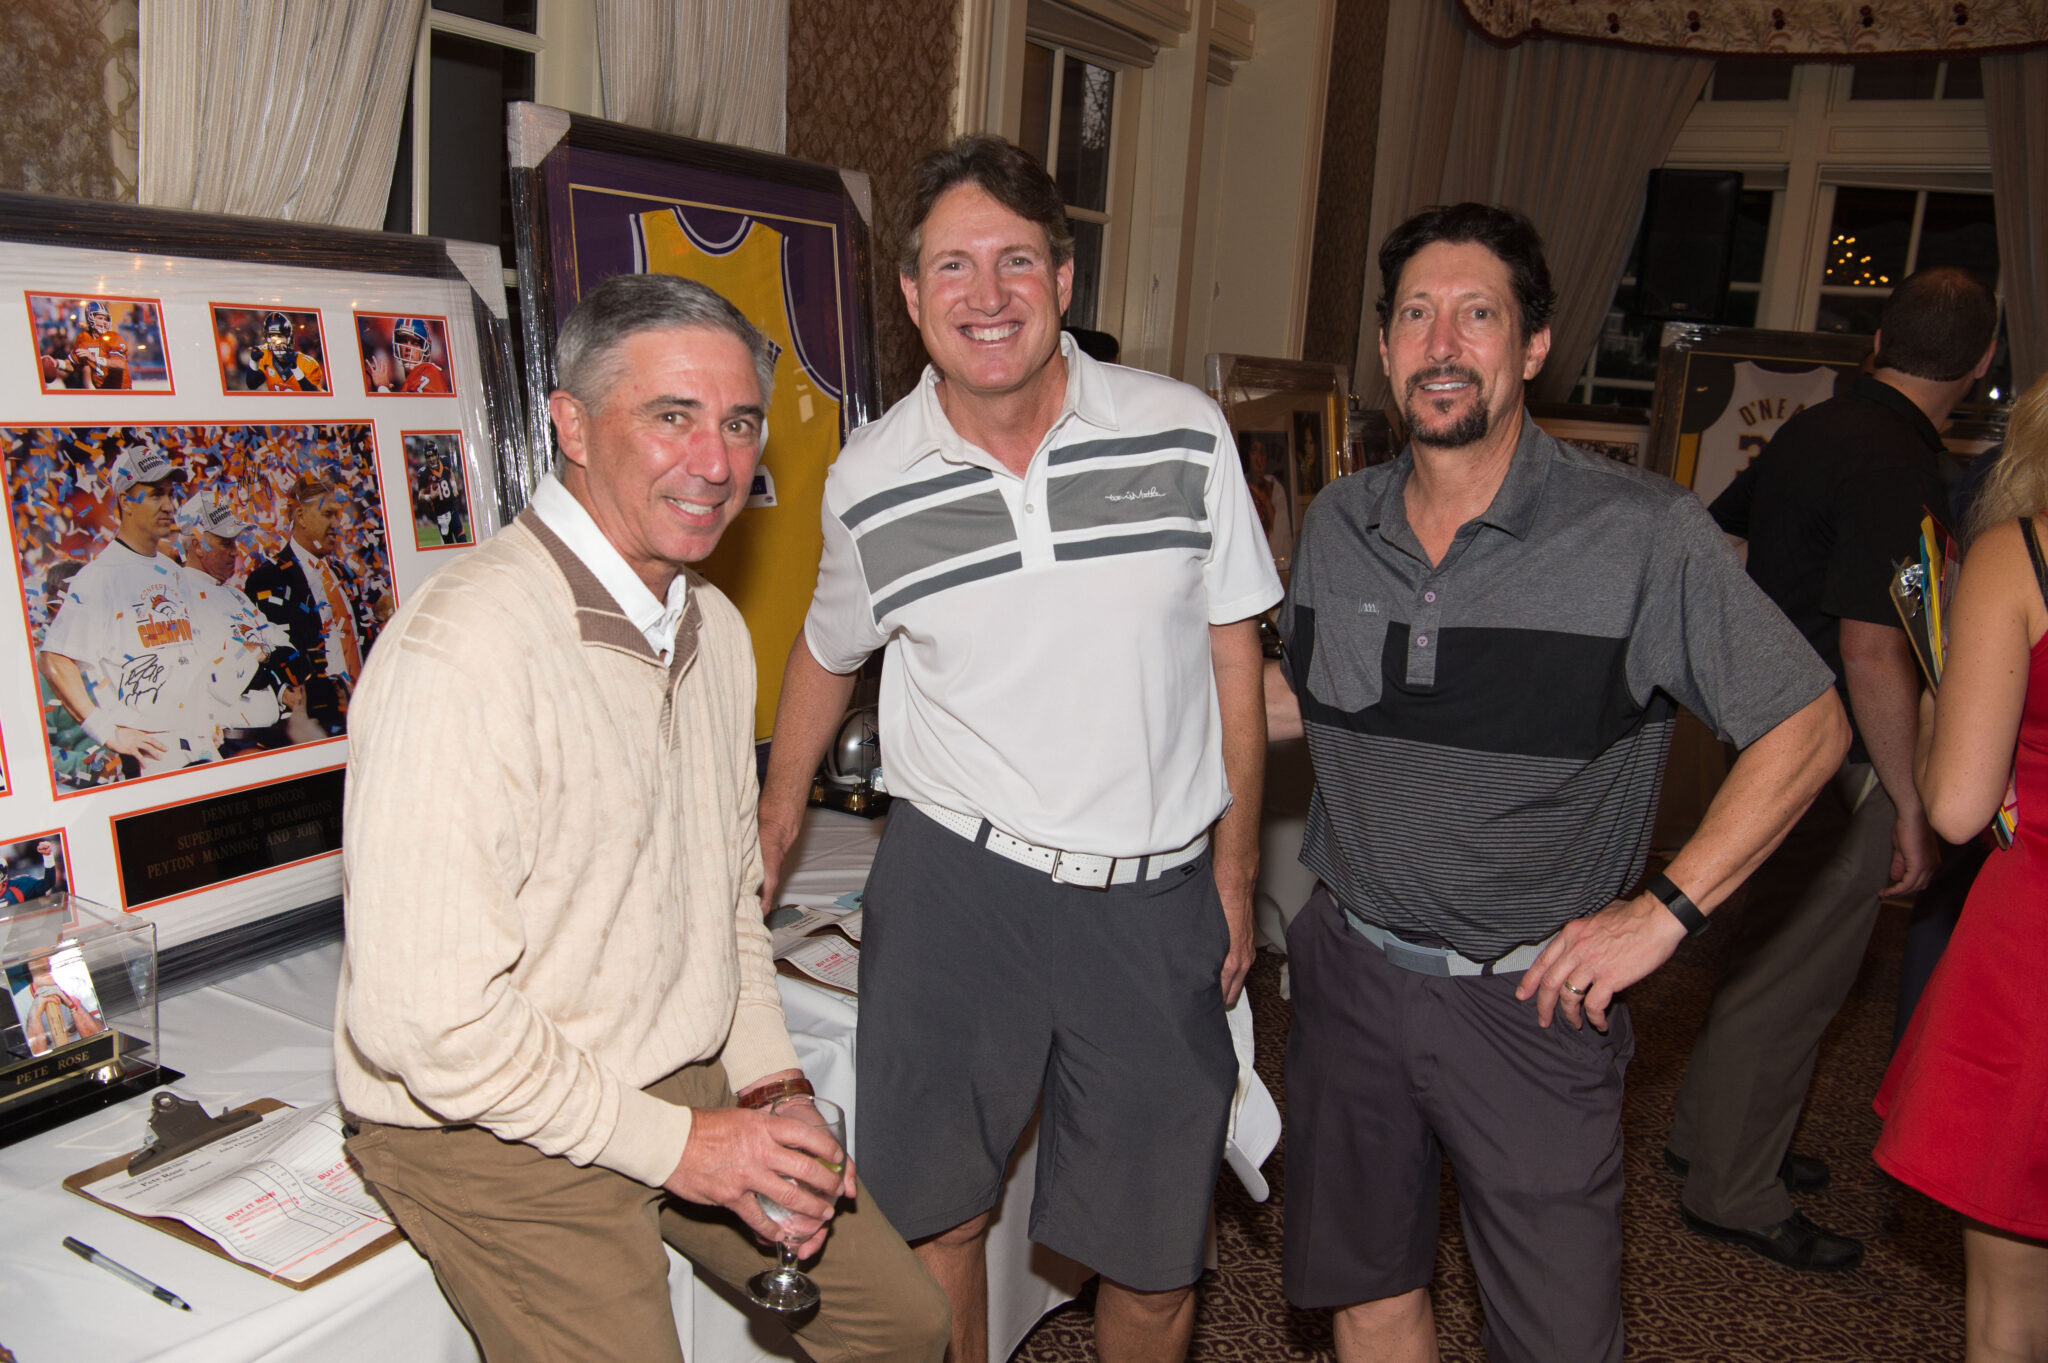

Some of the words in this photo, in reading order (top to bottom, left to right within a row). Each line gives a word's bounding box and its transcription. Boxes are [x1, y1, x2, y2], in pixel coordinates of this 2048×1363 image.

[201, 801, 250, 824] DENVER
[257, 786, 306, 809] BRONCOS
[177, 822, 247, 850] SUPERBOWL
[252, 816, 265, 831] 50
[272, 800, 333, 826] CHAMPIONS
[147, 854, 195, 880] PEYTON
[202, 837, 260, 864] MANNING
[266, 828, 290, 847] AND
[296, 819, 324, 840] JOHN
[16, 1065, 48, 1086] PETE
[58, 1051, 90, 1070] ROSE
[317, 1168, 335, 1180] BUY
[335, 1161, 344, 1170] IT
[225, 1208, 244, 1220] BUY
[245, 1202, 255, 1210] IT
[255, 1191, 276, 1204] NOW
